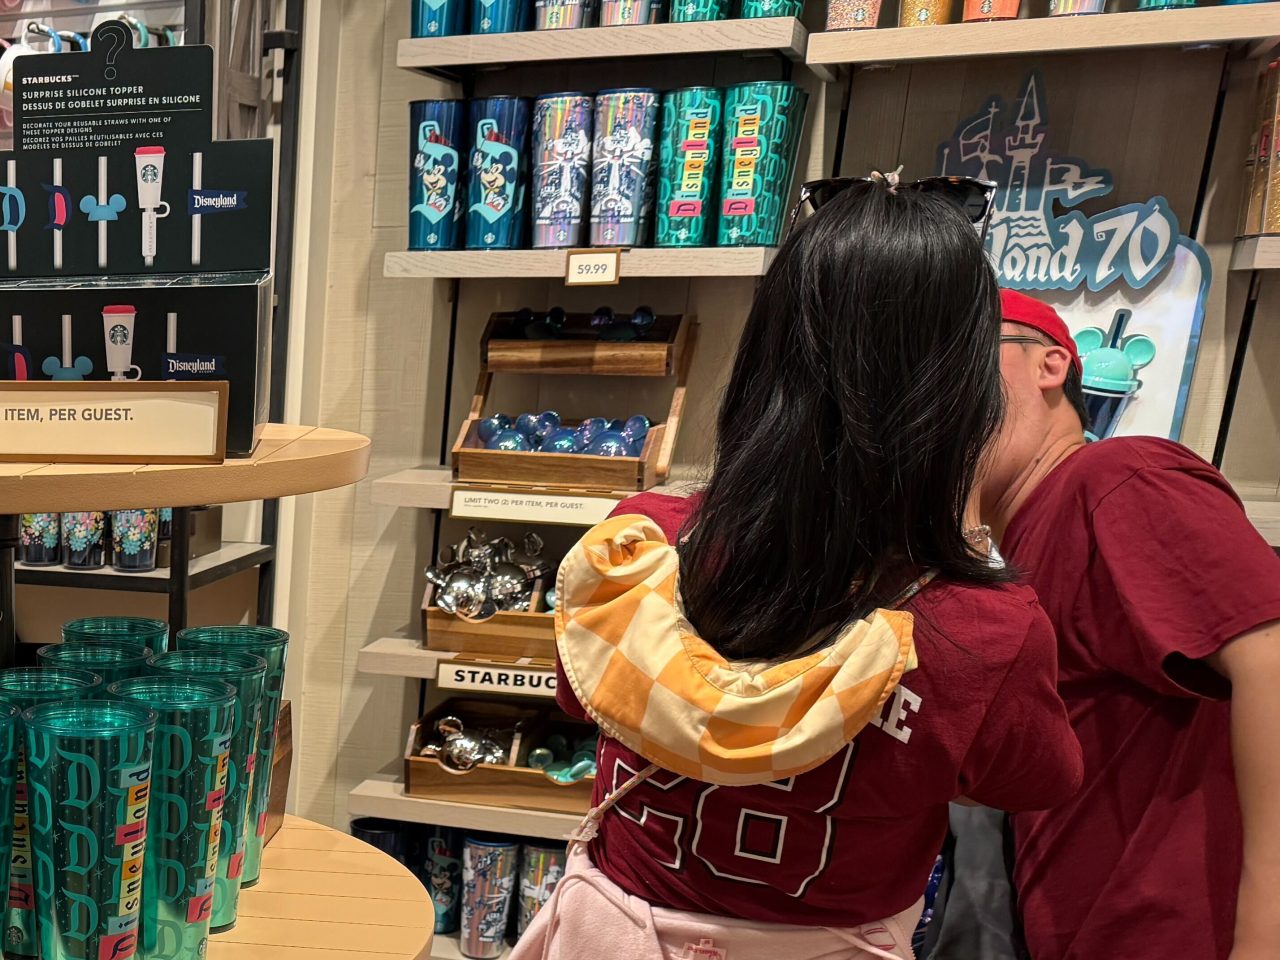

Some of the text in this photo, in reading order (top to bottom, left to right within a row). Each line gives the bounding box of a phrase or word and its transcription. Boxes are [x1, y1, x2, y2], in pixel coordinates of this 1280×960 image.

[22, 75, 72, 85] STARBUCKS
[22, 86, 144, 99] SURPRISE SILICONE TOPPER
[22, 102, 53, 110] DESSUS
[56, 101, 66, 109] DE
[68, 99, 104, 109] GOBELET
[107, 98, 146, 107] SURPRISE
[162, 95, 200, 104] SILICONE
[104, 118, 129, 126] STRAWS
[676, 110, 709, 215] Disneyland
[727, 106, 759, 214] Disneyland
[193, 193, 237, 208] Disneyland
[1093, 204, 1171, 284] 70
[577, 264, 608, 274] 59.99
[168, 358, 216, 373] Disneyland
[4, 408, 44, 423] ITEM,
[49, 408, 77, 421] PER
[81, 408, 134, 421] GUEST.
[454, 670, 556, 689] STARBUC
